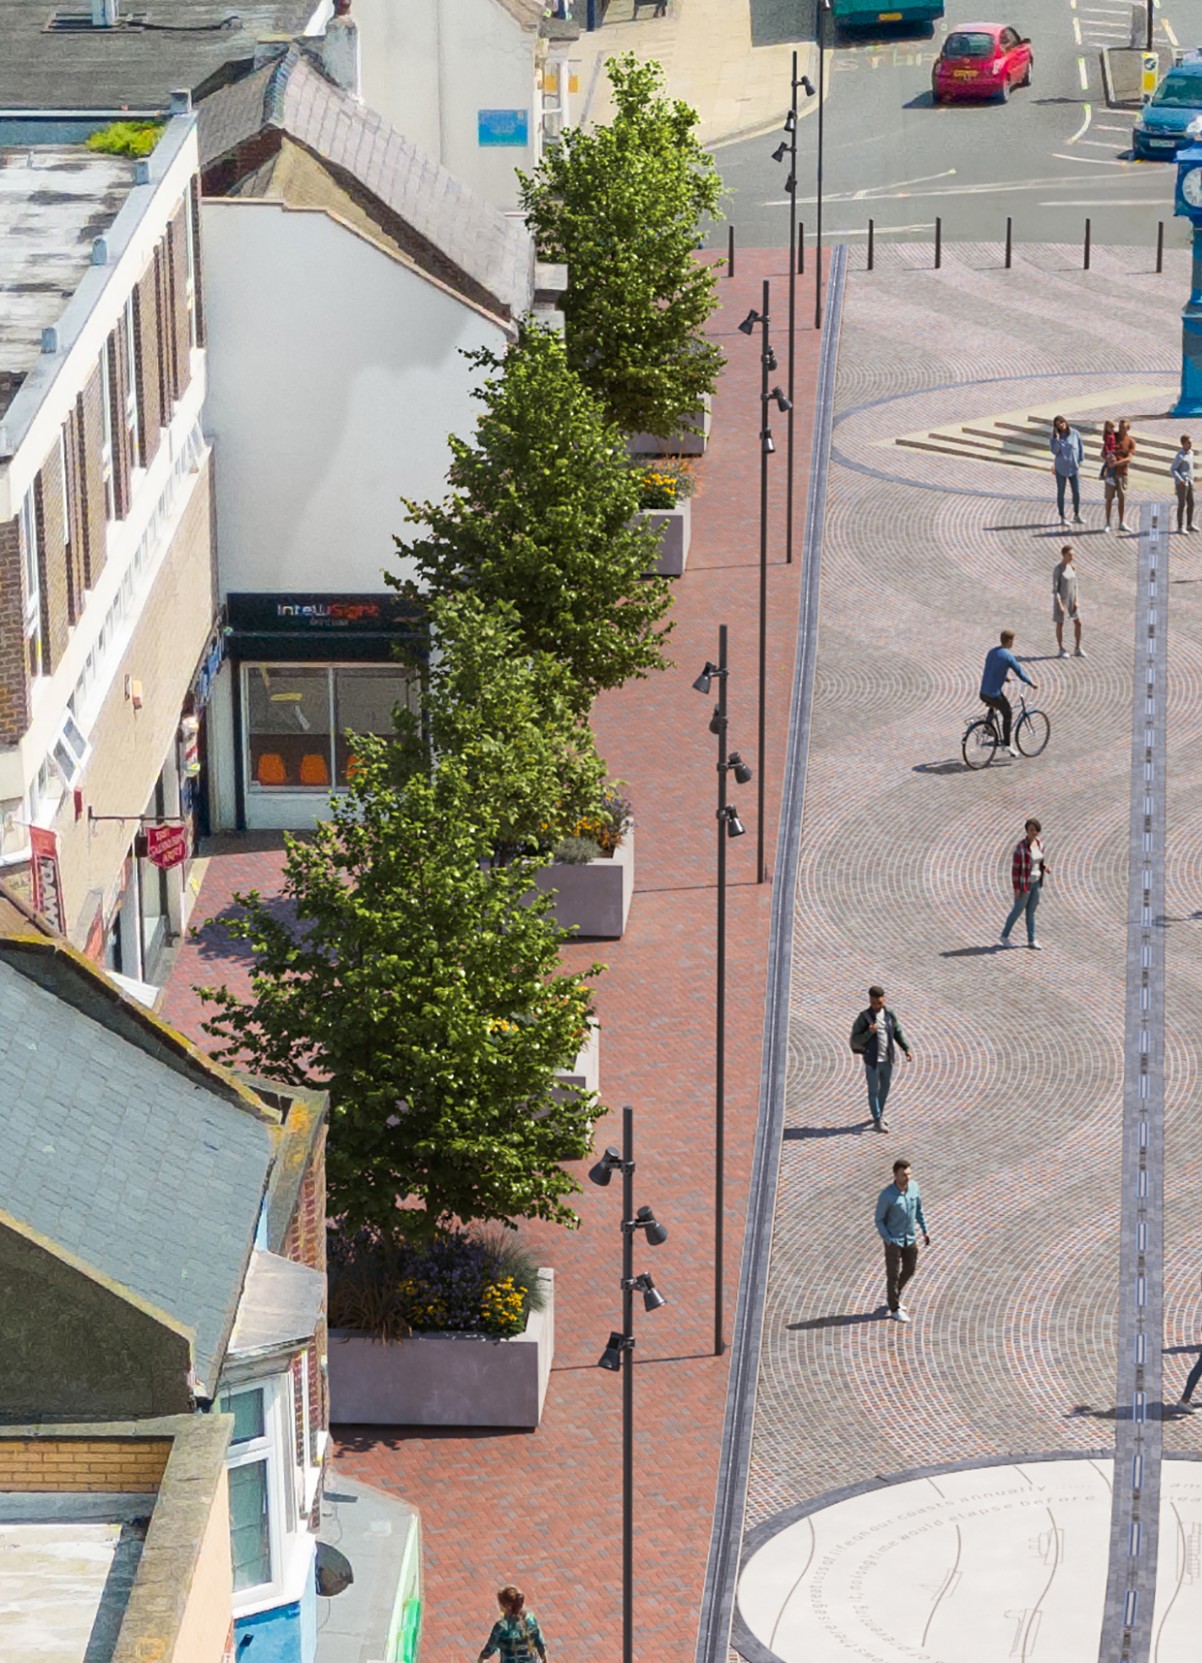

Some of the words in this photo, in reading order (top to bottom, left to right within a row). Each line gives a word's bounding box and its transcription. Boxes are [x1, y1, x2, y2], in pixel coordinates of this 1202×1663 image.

[869, 1519, 894, 1532] our
[896, 1499, 955, 1520] coasts
[959, 1484, 1047, 1503] annually
[899, 1518, 944, 1541] would
[947, 1502, 1014, 1523] elapse
[1020, 1494, 1096, 1508] before
